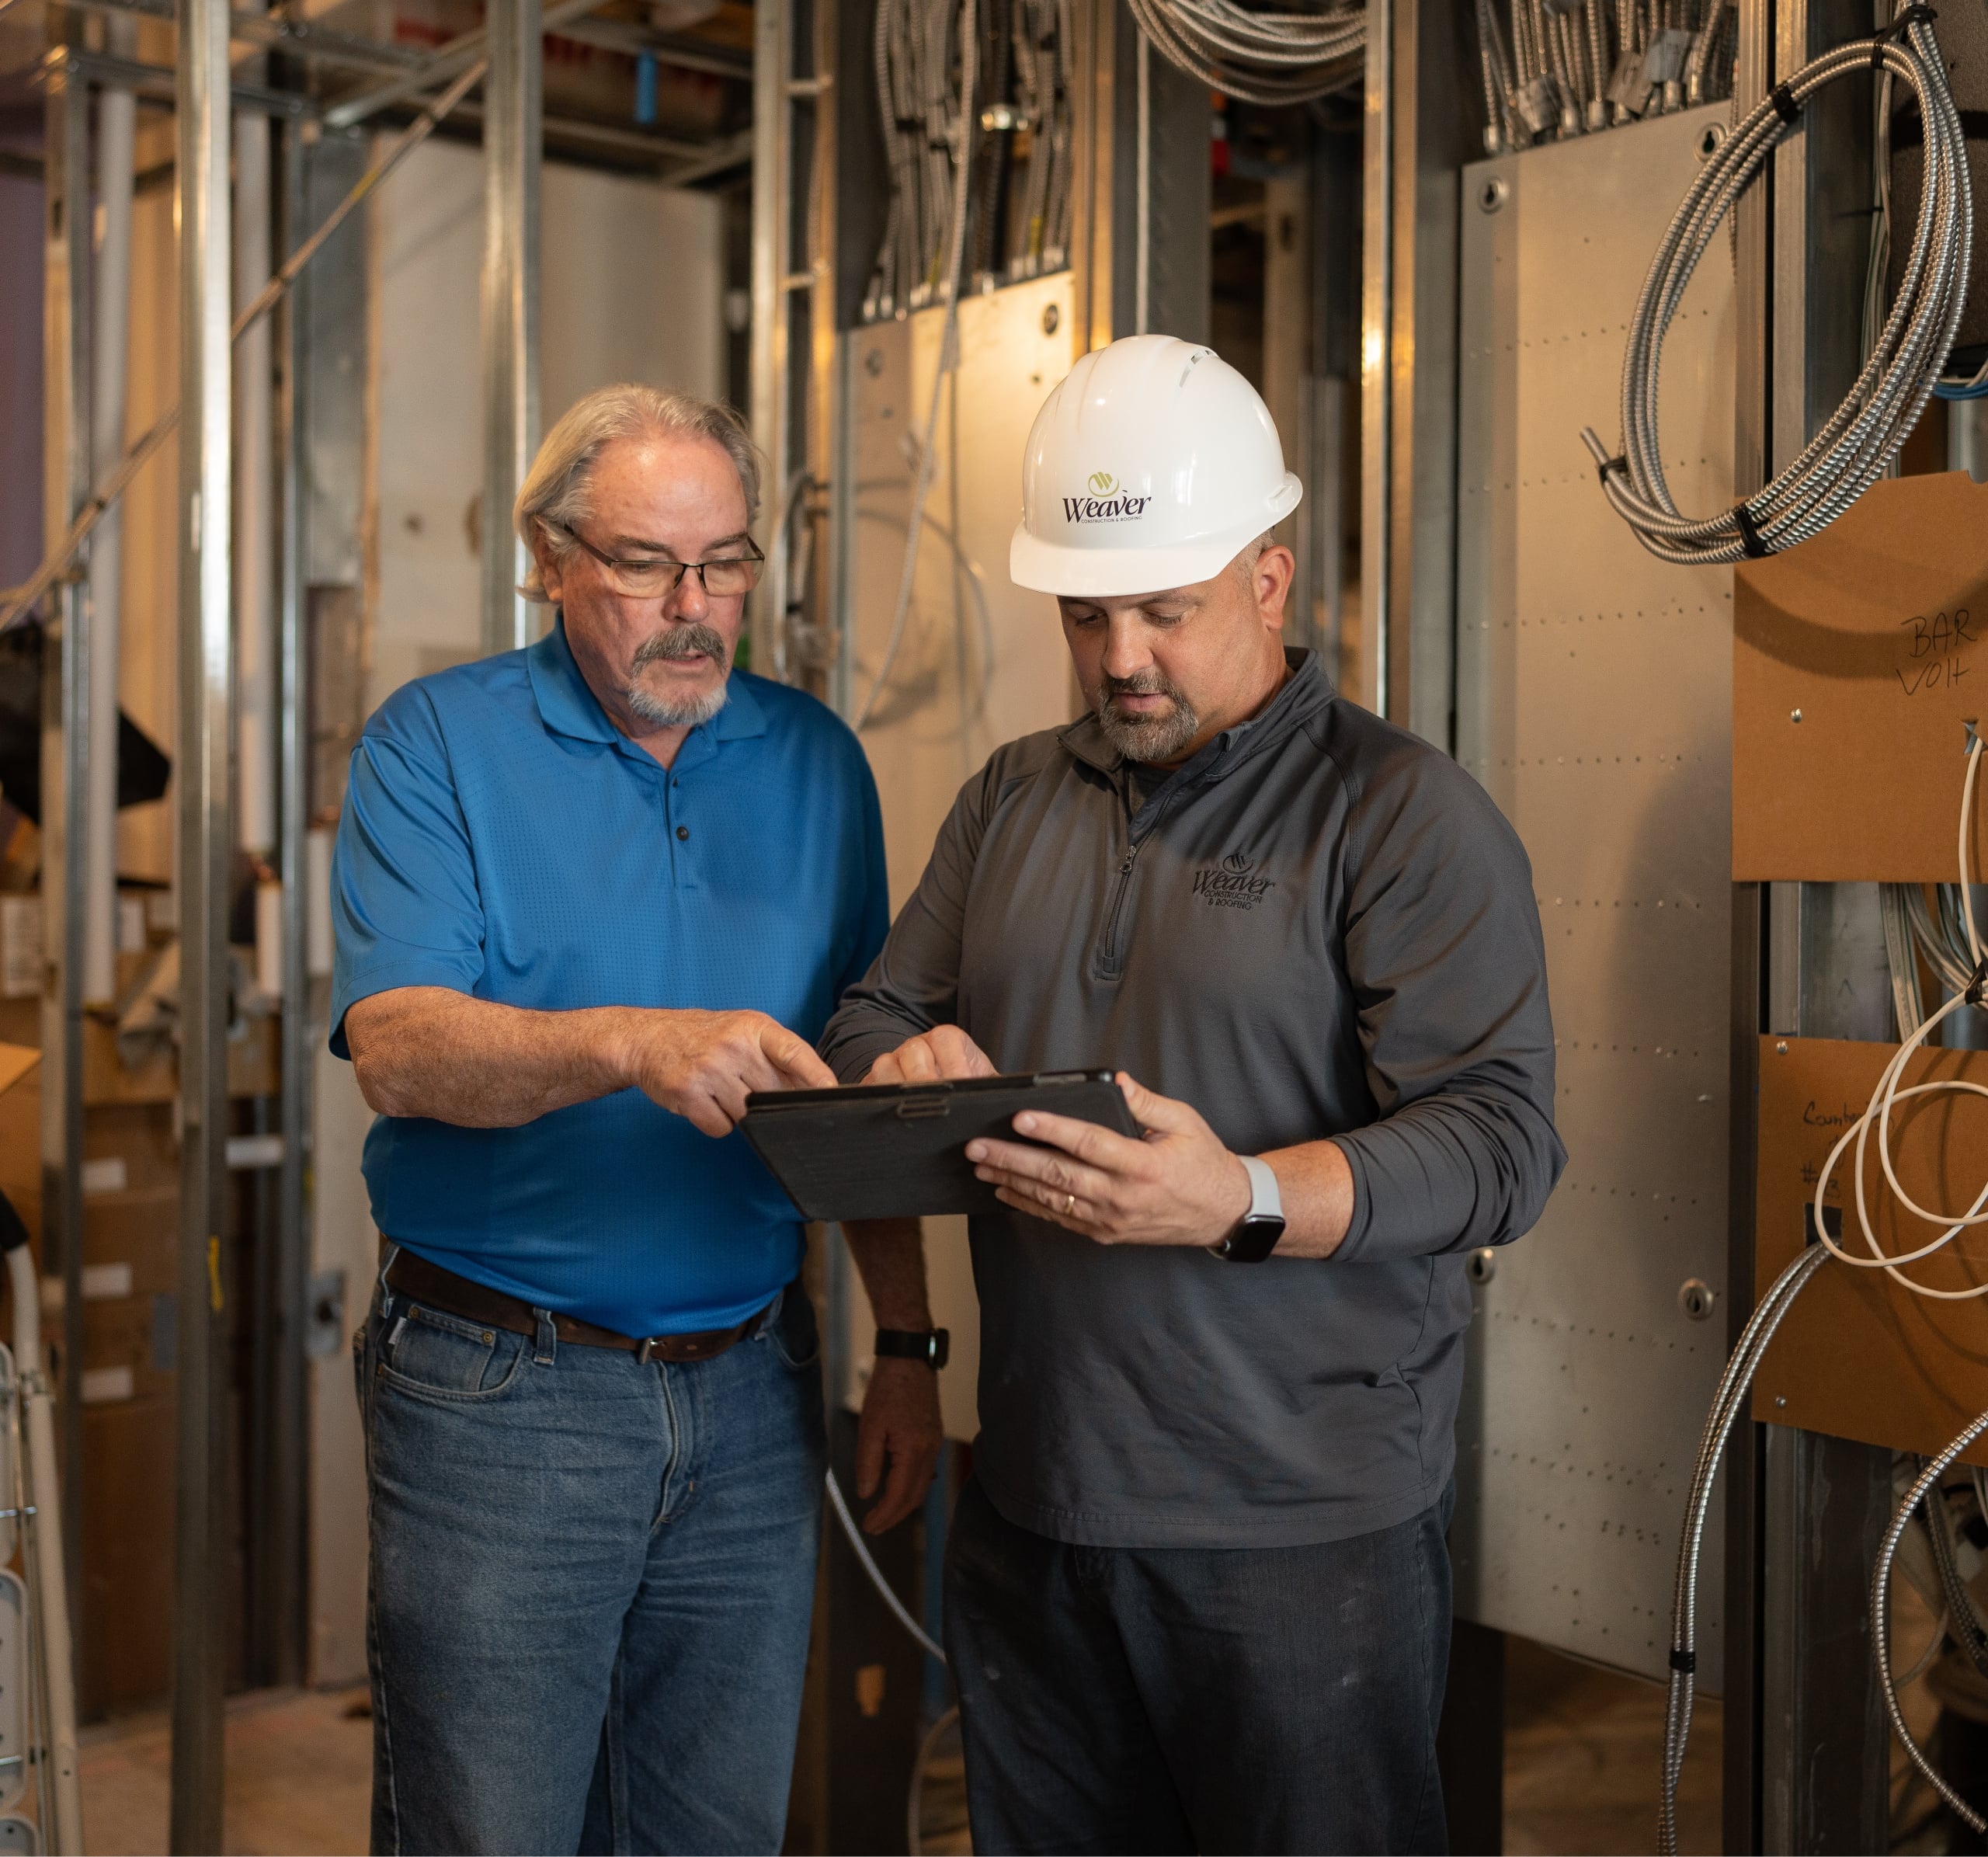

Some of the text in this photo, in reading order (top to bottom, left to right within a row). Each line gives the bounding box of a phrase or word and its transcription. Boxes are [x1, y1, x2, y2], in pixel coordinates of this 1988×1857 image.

[1062, 490, 1152, 523] Weaver
[1900, 609, 1978, 658] BAR
[1192, 870, 1275, 895] Weaver
[1204, 890, 1263, 903] CONSTRUCTION
[1215, 899, 1252, 910] ROOFING
